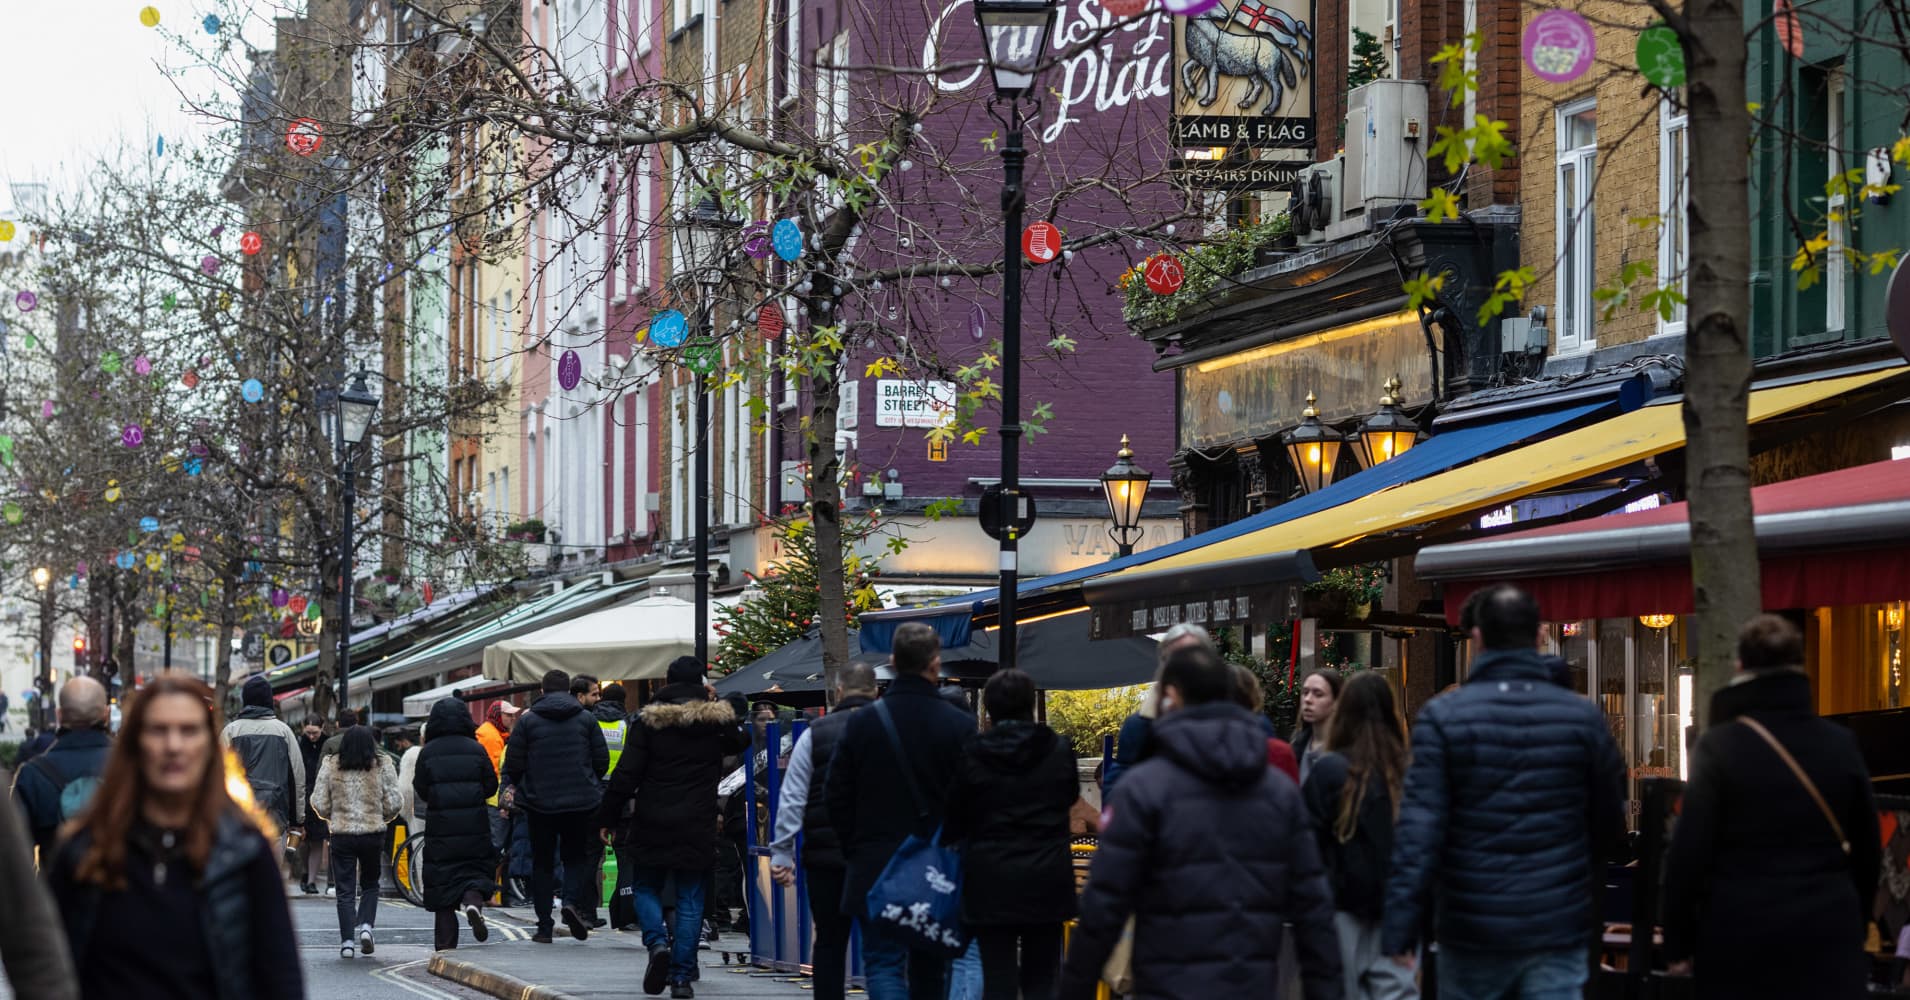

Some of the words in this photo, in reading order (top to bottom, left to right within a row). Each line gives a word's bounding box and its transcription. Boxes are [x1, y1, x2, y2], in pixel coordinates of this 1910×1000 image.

[1178, 123, 1231, 138] LAMB
[1236, 123, 1250, 139] &
[1257, 124, 1306, 140] FLAG
[1251, 169, 1299, 183] DININ
[884, 385, 937, 398] BARRETT
[884, 399, 926, 412] STREET
